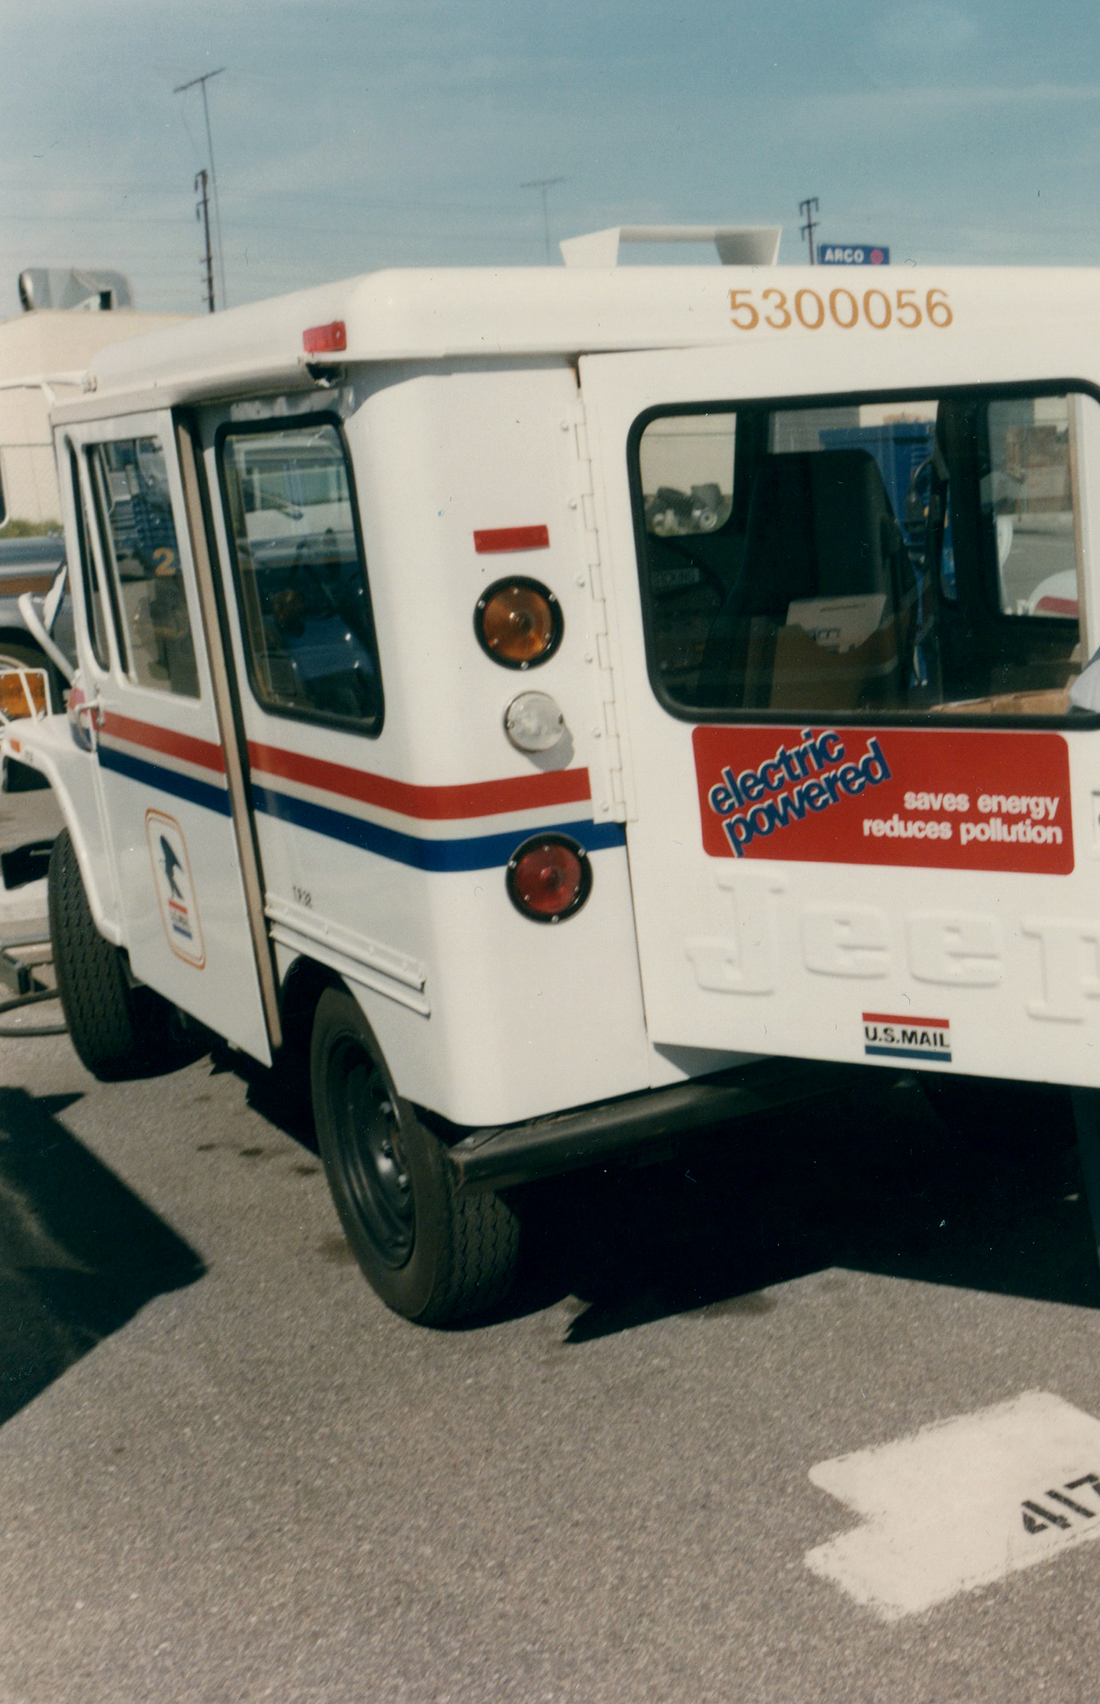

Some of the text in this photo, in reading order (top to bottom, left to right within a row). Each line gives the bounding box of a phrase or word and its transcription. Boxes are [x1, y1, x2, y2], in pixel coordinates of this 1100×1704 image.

[824, 248, 864, 263] ARCO
[730, 288, 953, 330] 5300056
[708, 727, 846, 816] electric
[722, 737, 893, 858] powered
[904, 791, 1060, 820] saves energy
[862, 814, 1063, 845] reduces pollution
